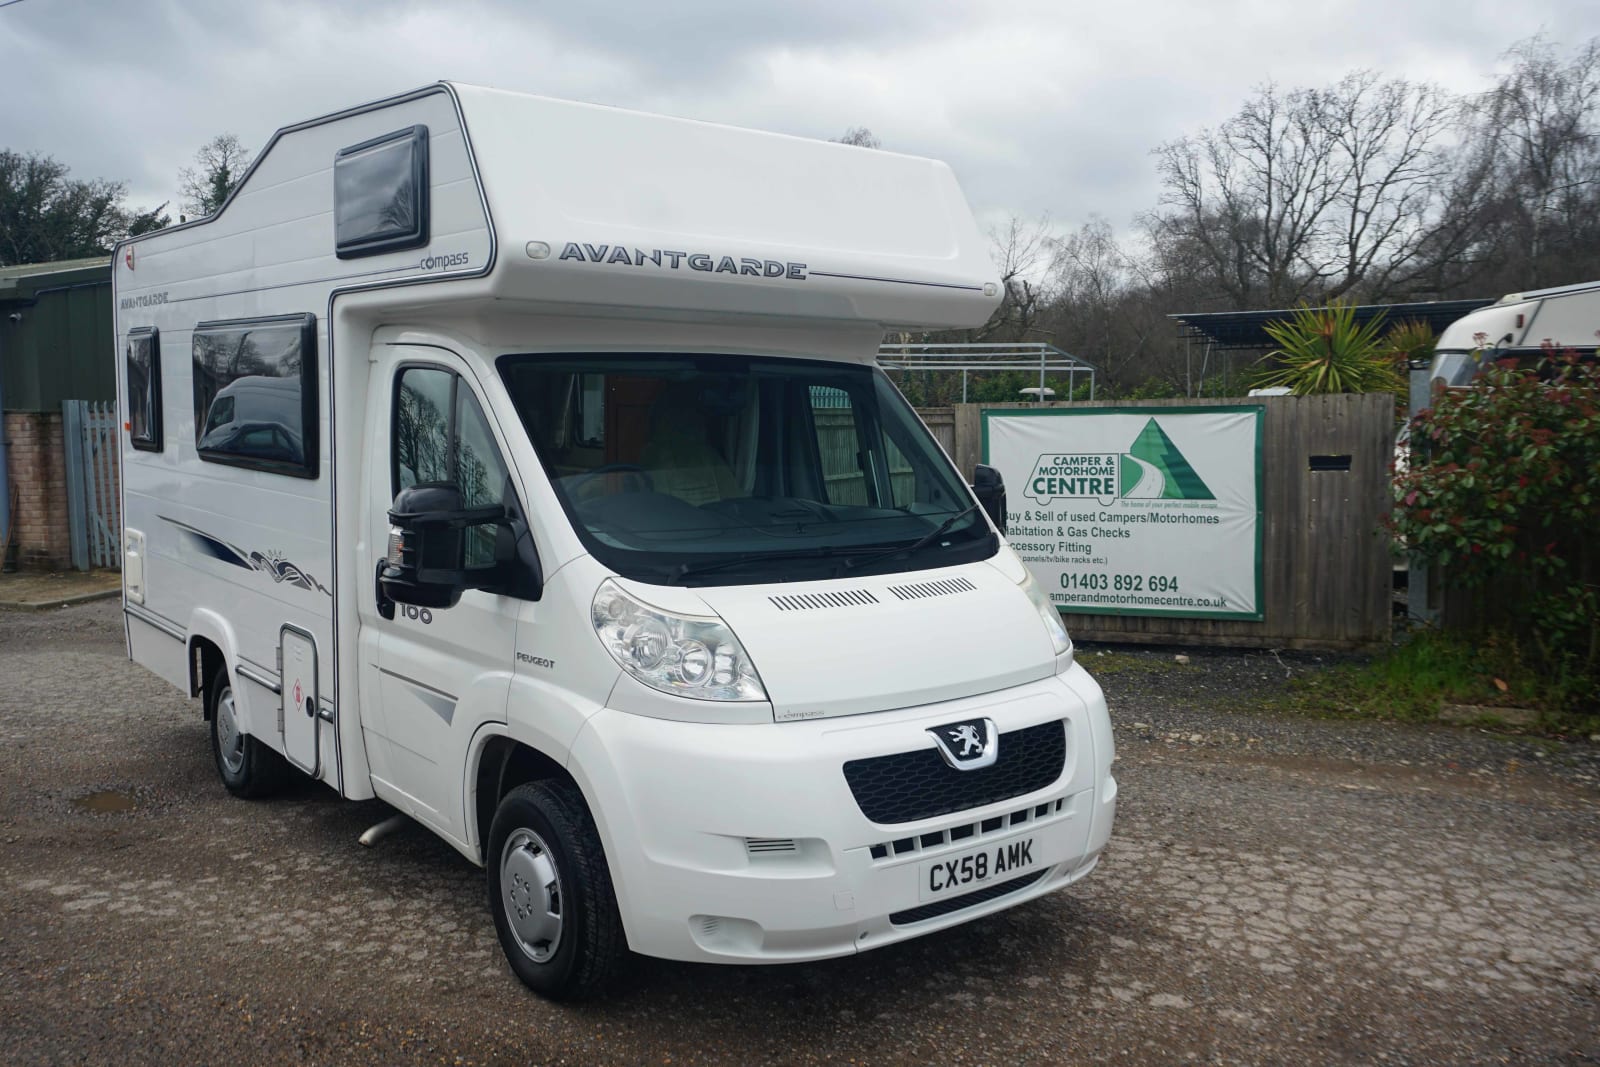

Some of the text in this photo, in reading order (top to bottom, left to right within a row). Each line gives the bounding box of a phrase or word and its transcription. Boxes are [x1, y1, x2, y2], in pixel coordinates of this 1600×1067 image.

[420, 252, 469, 271] compass
[559, 242, 807, 280] AVANTGARDE
[120, 291, 169, 310] AVANTGARDE
[1053, 456, 1115, 466] CAMPER &
[1038, 466, 1115, 476] MOTORHOME
[1032, 477, 1115, 495] CENTRE
[1024, 510, 1032, 521] &
[1034, 510, 1054, 521] Sell
[1056, 511, 1068, 522] of
[1070, 511, 1096, 522] used
[1098, 511, 1220, 525] Campers/Motorhomes
[1056, 526, 1065, 537] &
[1067, 526, 1088, 538] Gas
[1090, 526, 1131, 539] Checks
[1010, 541, 1092, 555] ccessory Fitting
[1071, 555, 1091, 564] racks
[1060, 572, 1179, 593] 01403 892 694
[1049, 592, 1227, 607] amperandmotorhomecentre.co.uk
[400, 602, 433, 625] 100
[516, 651, 556, 669] PEUGEOT
[929, 838, 1033, 892] CX58 AMK
